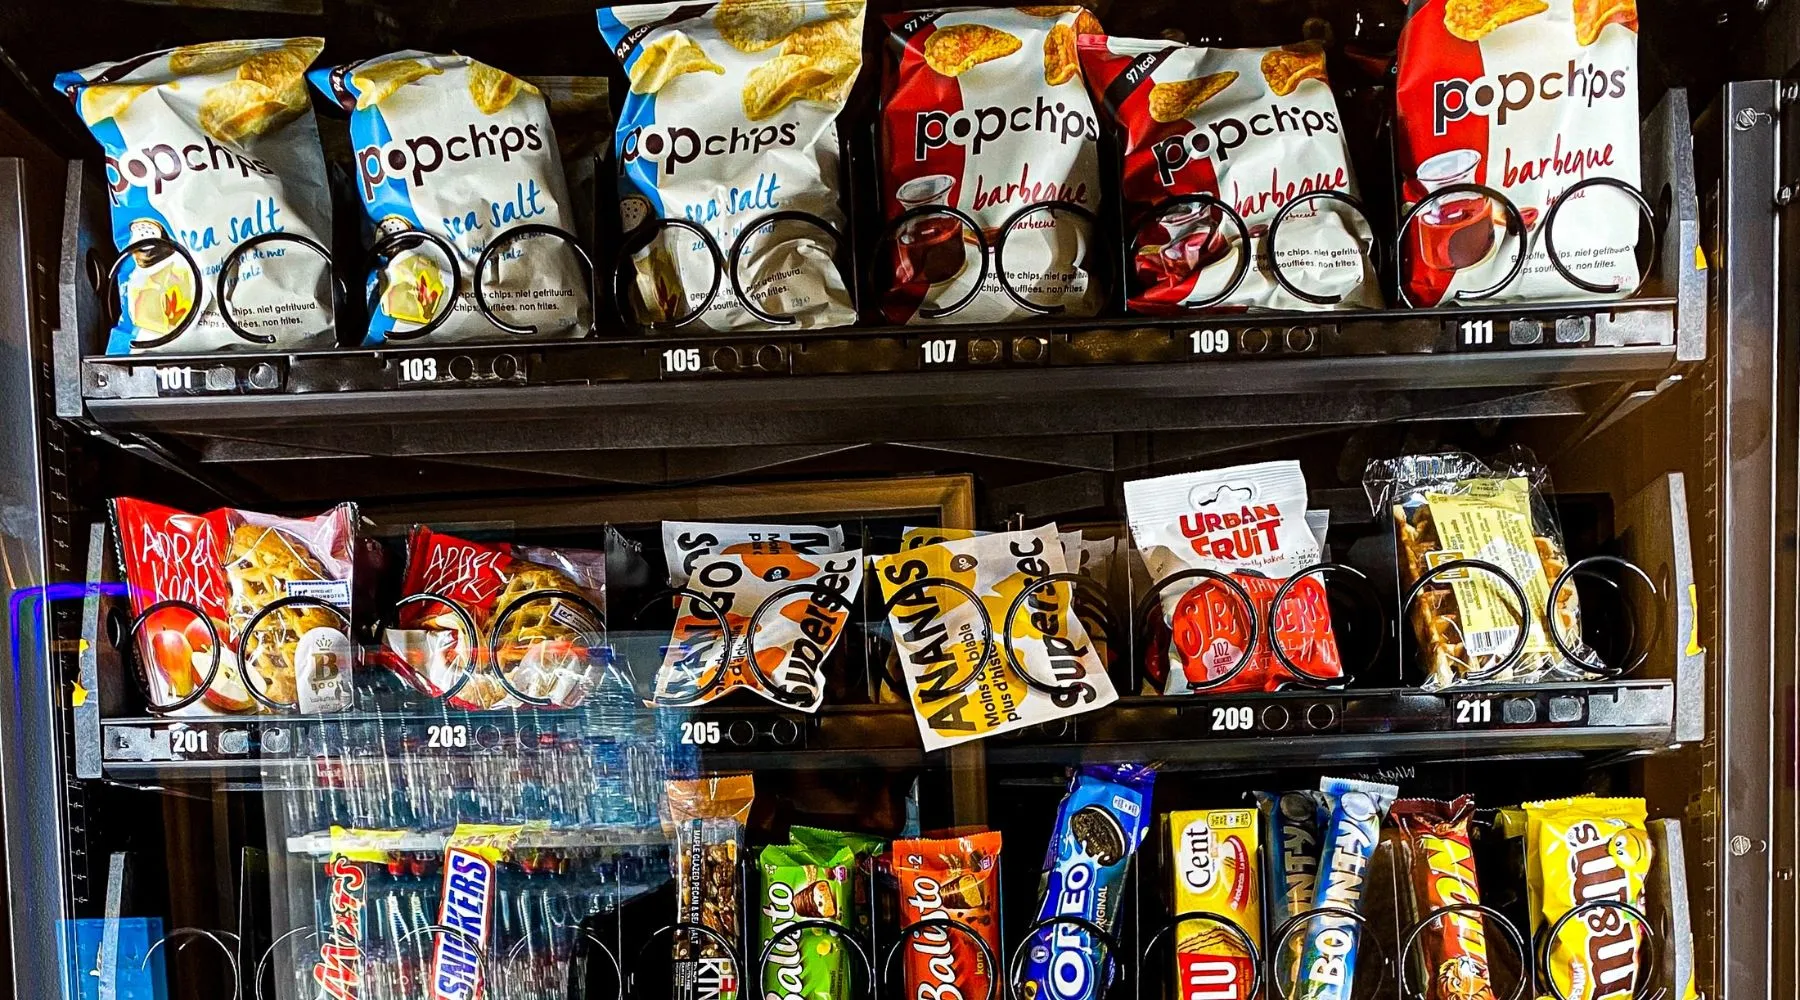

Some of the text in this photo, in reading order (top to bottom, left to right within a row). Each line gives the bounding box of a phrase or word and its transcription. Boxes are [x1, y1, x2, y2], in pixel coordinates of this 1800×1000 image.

[904, 19, 917, 31] 97
[616, 42, 630, 58] 94
[1125, 54, 1156, 84] 97 kcal
[1434, 60, 1626, 136] popchips
[916, 96, 1098, 160] popchips
[619, 123, 798, 176] popchips
[1152, 104, 1338, 186] popchips
[358, 124, 542, 201] popchips
[1503, 133, 1614, 188] barbeque
[684, 173, 780, 225] sea salt
[1233, 167, 1347, 217] barbeque
[443, 179, 545, 240] sea salt
[181, 197, 285, 251] sea salt
[1288, 248, 1312, 257] chips.
[1314, 248, 1329, 256] niet
[1335, 260, 1359, 268] frites.
[1575, 247, 1591, 257] niet
[1017, 271, 1042, 280] chips.
[1576, 262, 1592, 270] non
[1594, 260, 1616, 268] frites.
[489, 290, 514, 299] chips.
[516, 289, 531, 298] niet
[533, 288, 575, 298] gefrituurd.
[257, 305, 273, 313] niet
[538, 303, 560, 312] frites.
[263, 319, 277, 327] non
[1461, 320, 1493, 344] 111
[921, 339, 957, 363] 107
[1190, 329, 1229, 353] 109
[400, 357, 437, 381] 103
[663, 348, 700, 372] 105
[160, 367, 192, 390] 101
[1179, 503, 1281, 539] URBAN
[1263, 553, 1285, 564] baked
[1009, 536, 1097, 708] supersec
[884, 559, 977, 731] ANANAS
[959, 623, 980, 662] blabla
[1213, 641, 1230, 658] 102
[312, 653, 339, 682] B
[979, 683, 1000, 727] Moins
[1001, 693, 1022, 722] plus
[1457, 700, 1491, 722] 211
[1212, 707, 1254, 730] 209
[172, 730, 208, 752] 201
[428, 725, 467, 747] 203
[680, 722, 721, 744] 205
[692, 854, 701, 880] GLAZED
[1186, 827, 1211, 888] Cent
[691, 881, 700, 905] PECAN
[1095, 885, 1108, 927] RIGINAL
[690, 928, 699, 945] ALT
[1053, 863, 1090, 997] OREO
[975, 951, 984, 975] korn
[1190, 961, 1237, 1000] LU
